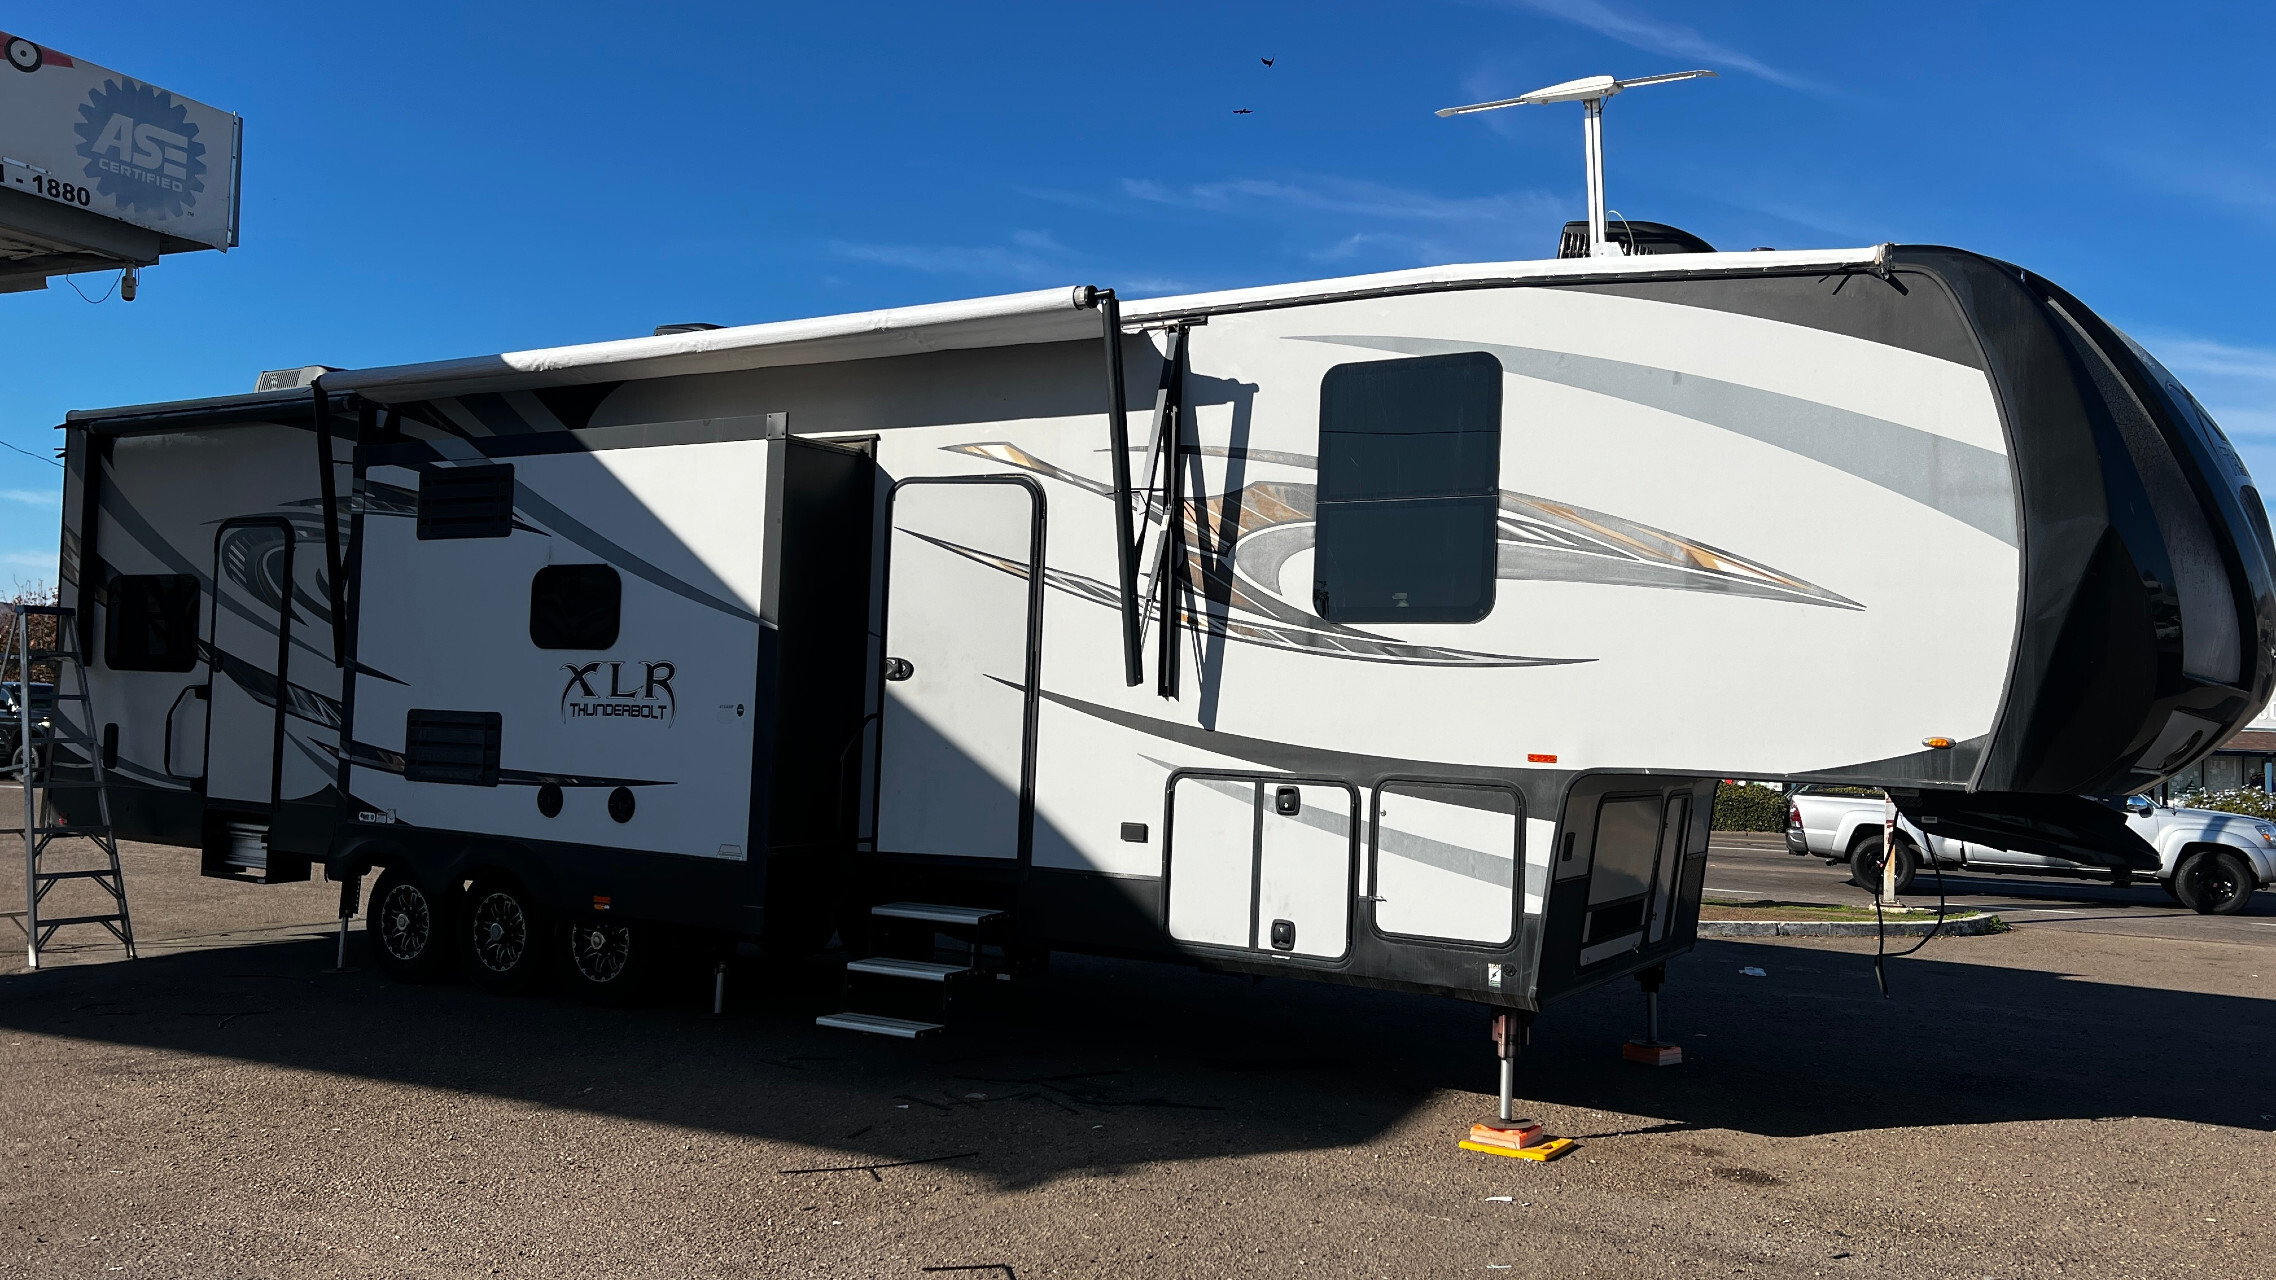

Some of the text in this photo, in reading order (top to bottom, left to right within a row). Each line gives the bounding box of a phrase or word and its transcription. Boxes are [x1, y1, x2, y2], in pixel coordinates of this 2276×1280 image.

[91, 113, 188, 180] ASE
[32, 174, 91, 207] 1880
[98, 158, 183, 193] CERTIFIED
[560, 660, 677, 728] XLR
[570, 702, 667, 720] THUNDERBOLT
